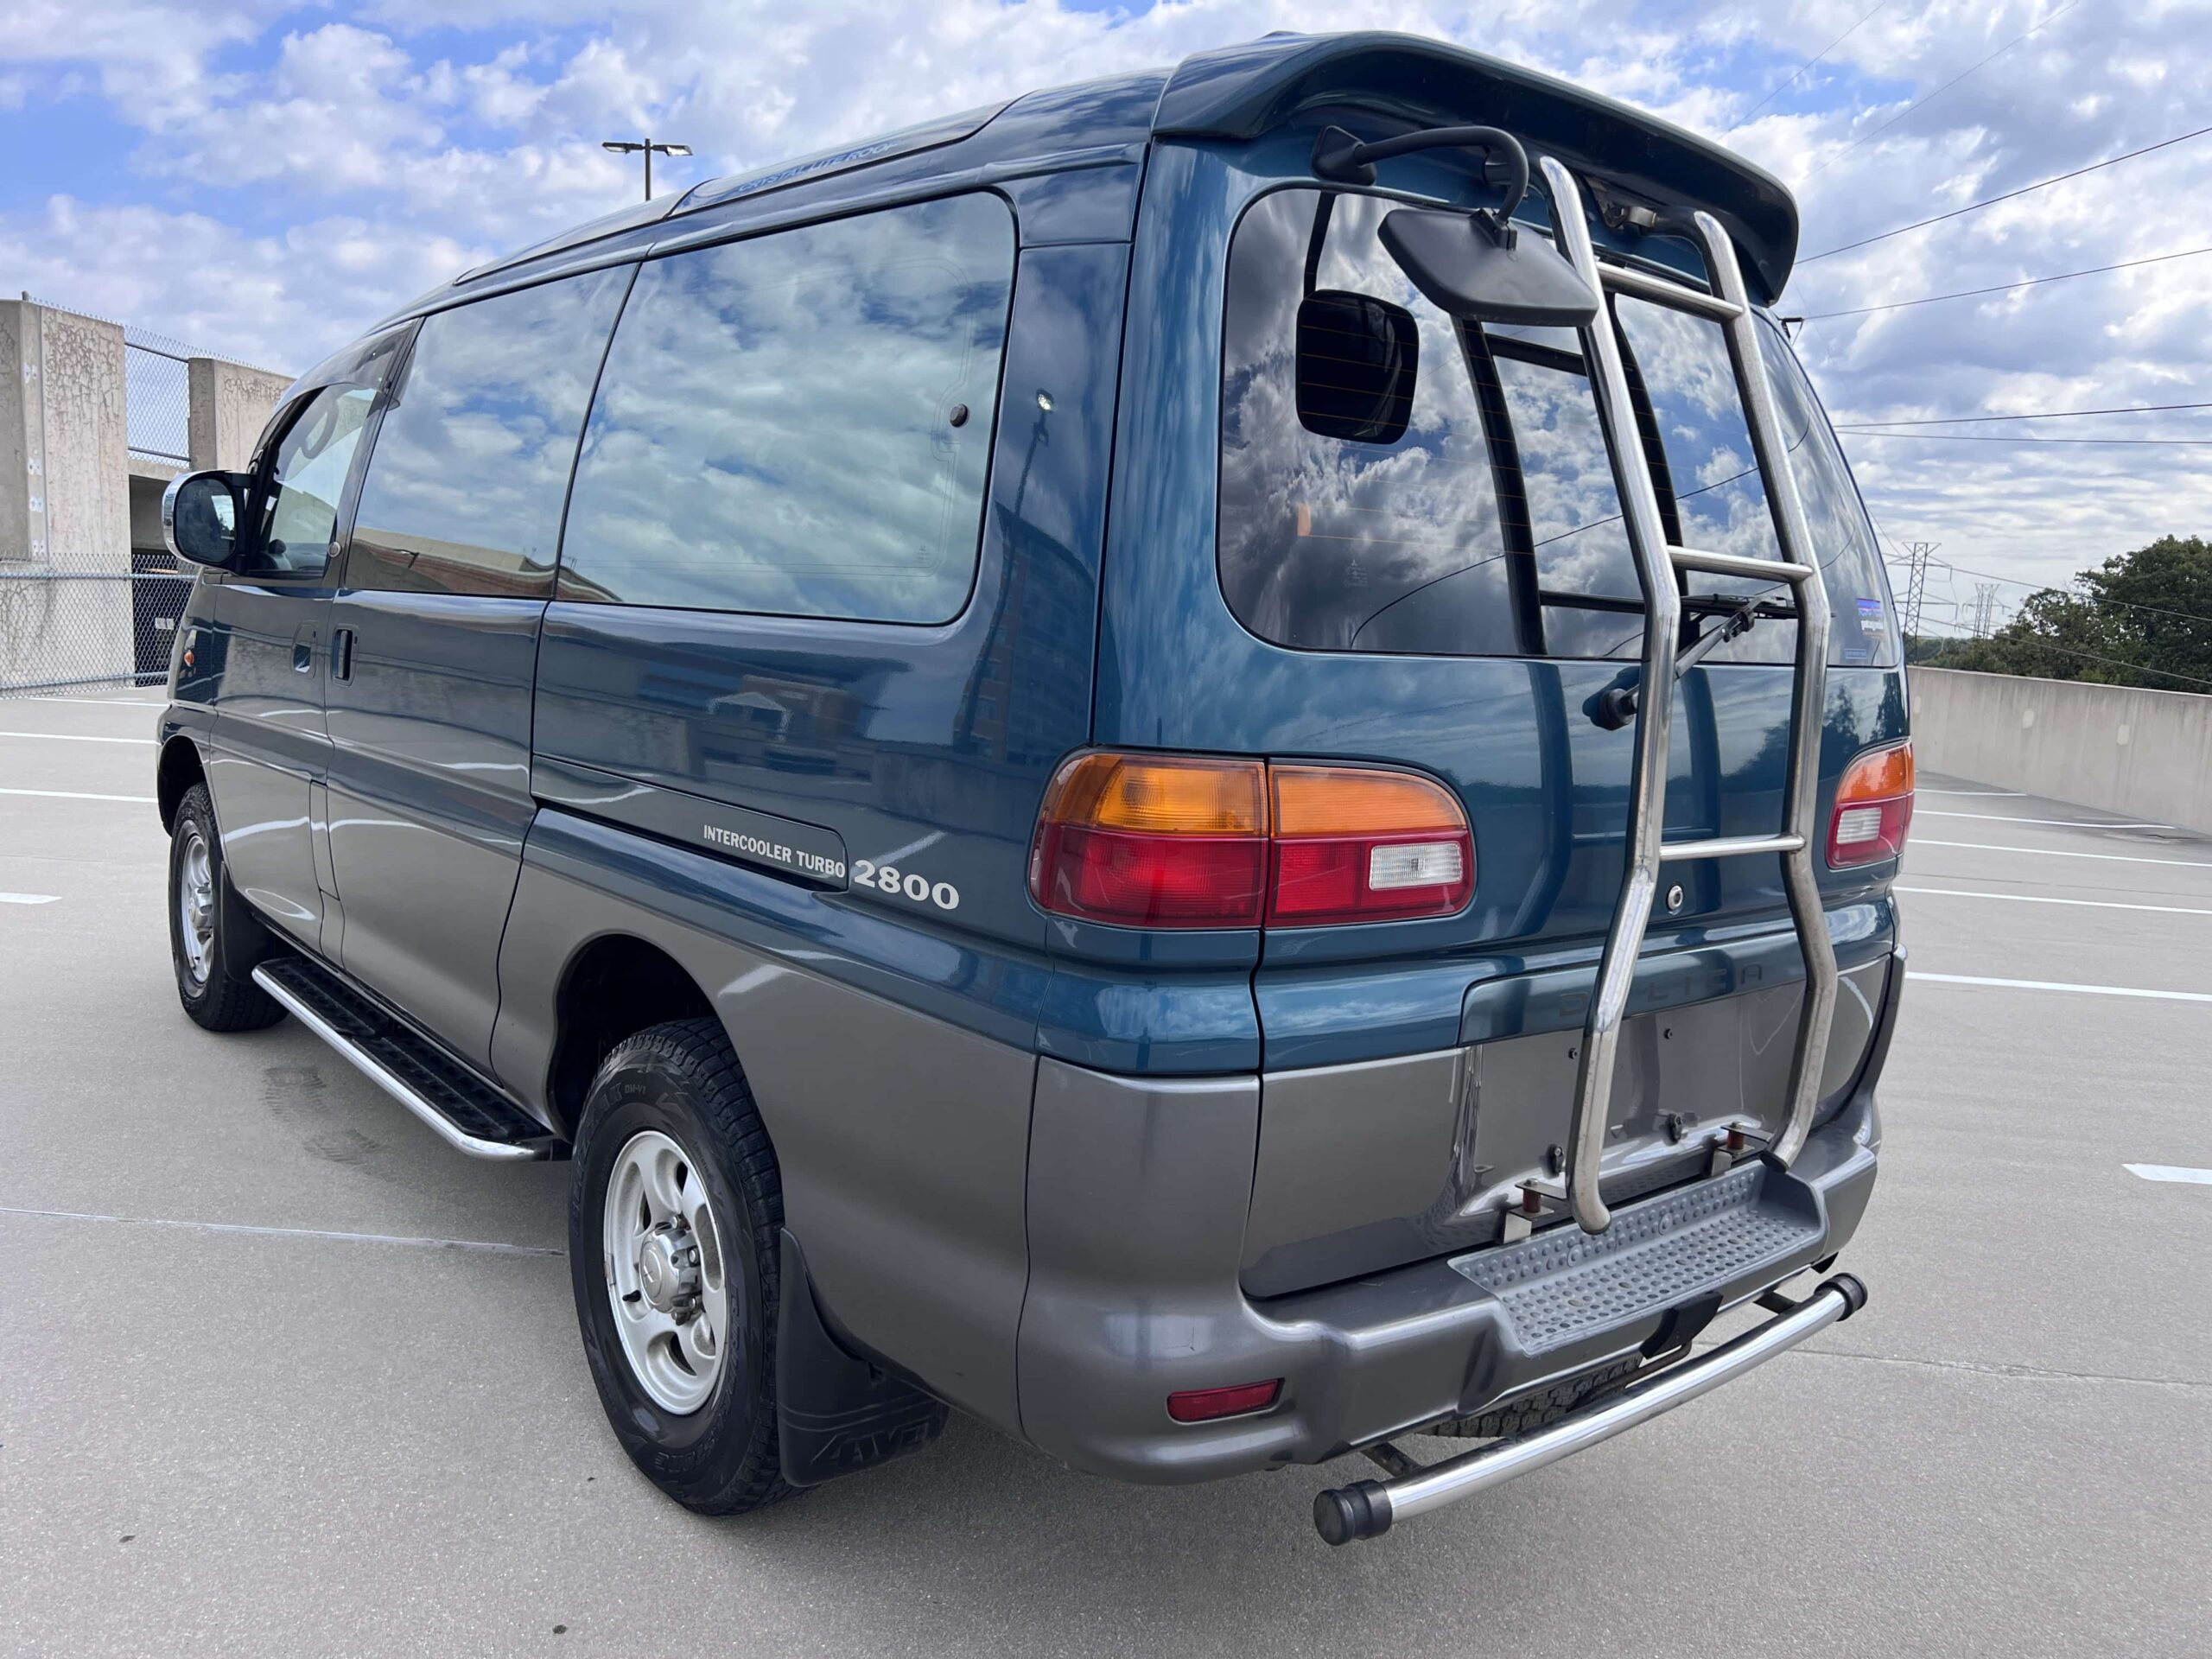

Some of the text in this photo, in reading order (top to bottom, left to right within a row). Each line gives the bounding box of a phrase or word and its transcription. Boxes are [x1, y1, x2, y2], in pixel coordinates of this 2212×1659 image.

[739, 166, 808, 192] CRYSTAL
[703, 824, 846, 878] INTERCOOLER TURBO
[854, 859, 960, 910] 2800
[1559, 961, 1763, 1017] DLICA
